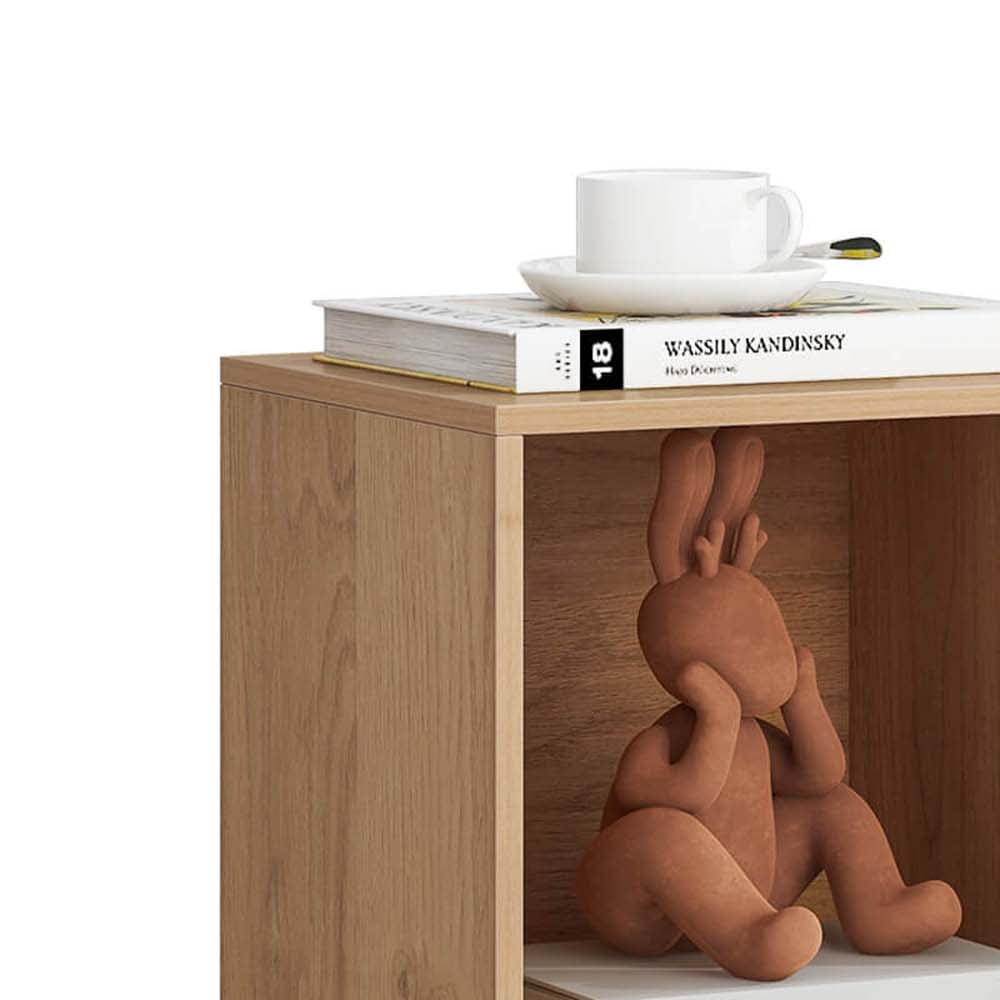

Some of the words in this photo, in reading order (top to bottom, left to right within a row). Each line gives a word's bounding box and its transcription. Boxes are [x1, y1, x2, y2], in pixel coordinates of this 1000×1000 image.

[591, 341, 613, 381] 18
[665, 338, 740, 357] WASSILY
[745, 333, 846, 354] KANDINSKY
